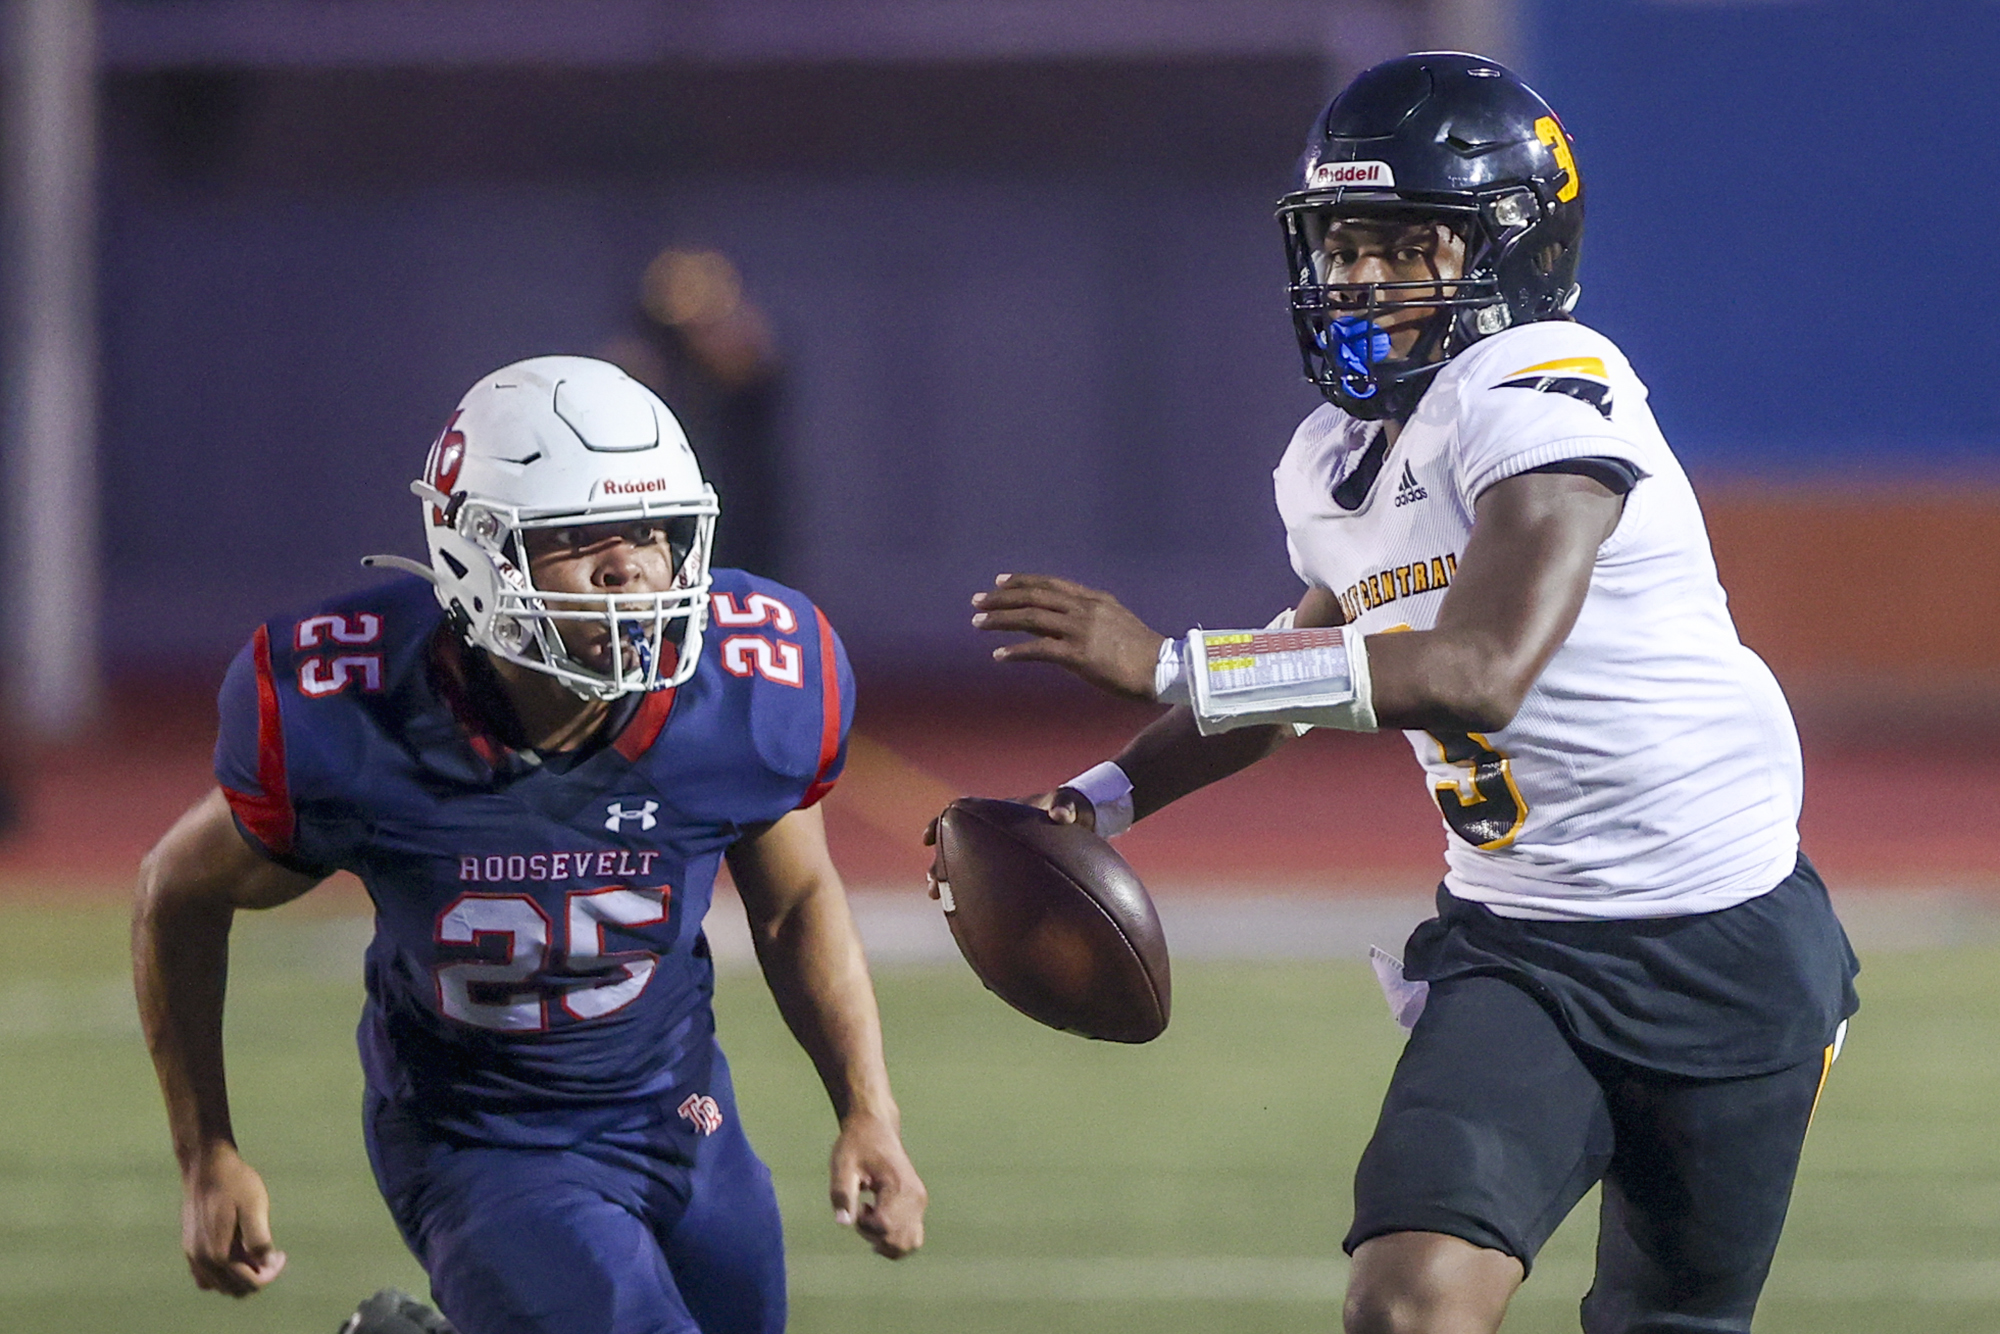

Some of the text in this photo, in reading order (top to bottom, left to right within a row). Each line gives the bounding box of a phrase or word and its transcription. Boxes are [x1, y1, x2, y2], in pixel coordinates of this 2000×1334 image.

[1317, 165, 1379, 182] Riddell
[1534, 115, 1580, 203] 3
[603, 478, 666, 494] Riddell
[1394, 487, 1428, 508] adidas
[294, 611, 384, 699] 25
[710, 591, 803, 688] 25
[459, 850, 660, 882] ROOSEVELT
[433, 884, 671, 1033] 25
